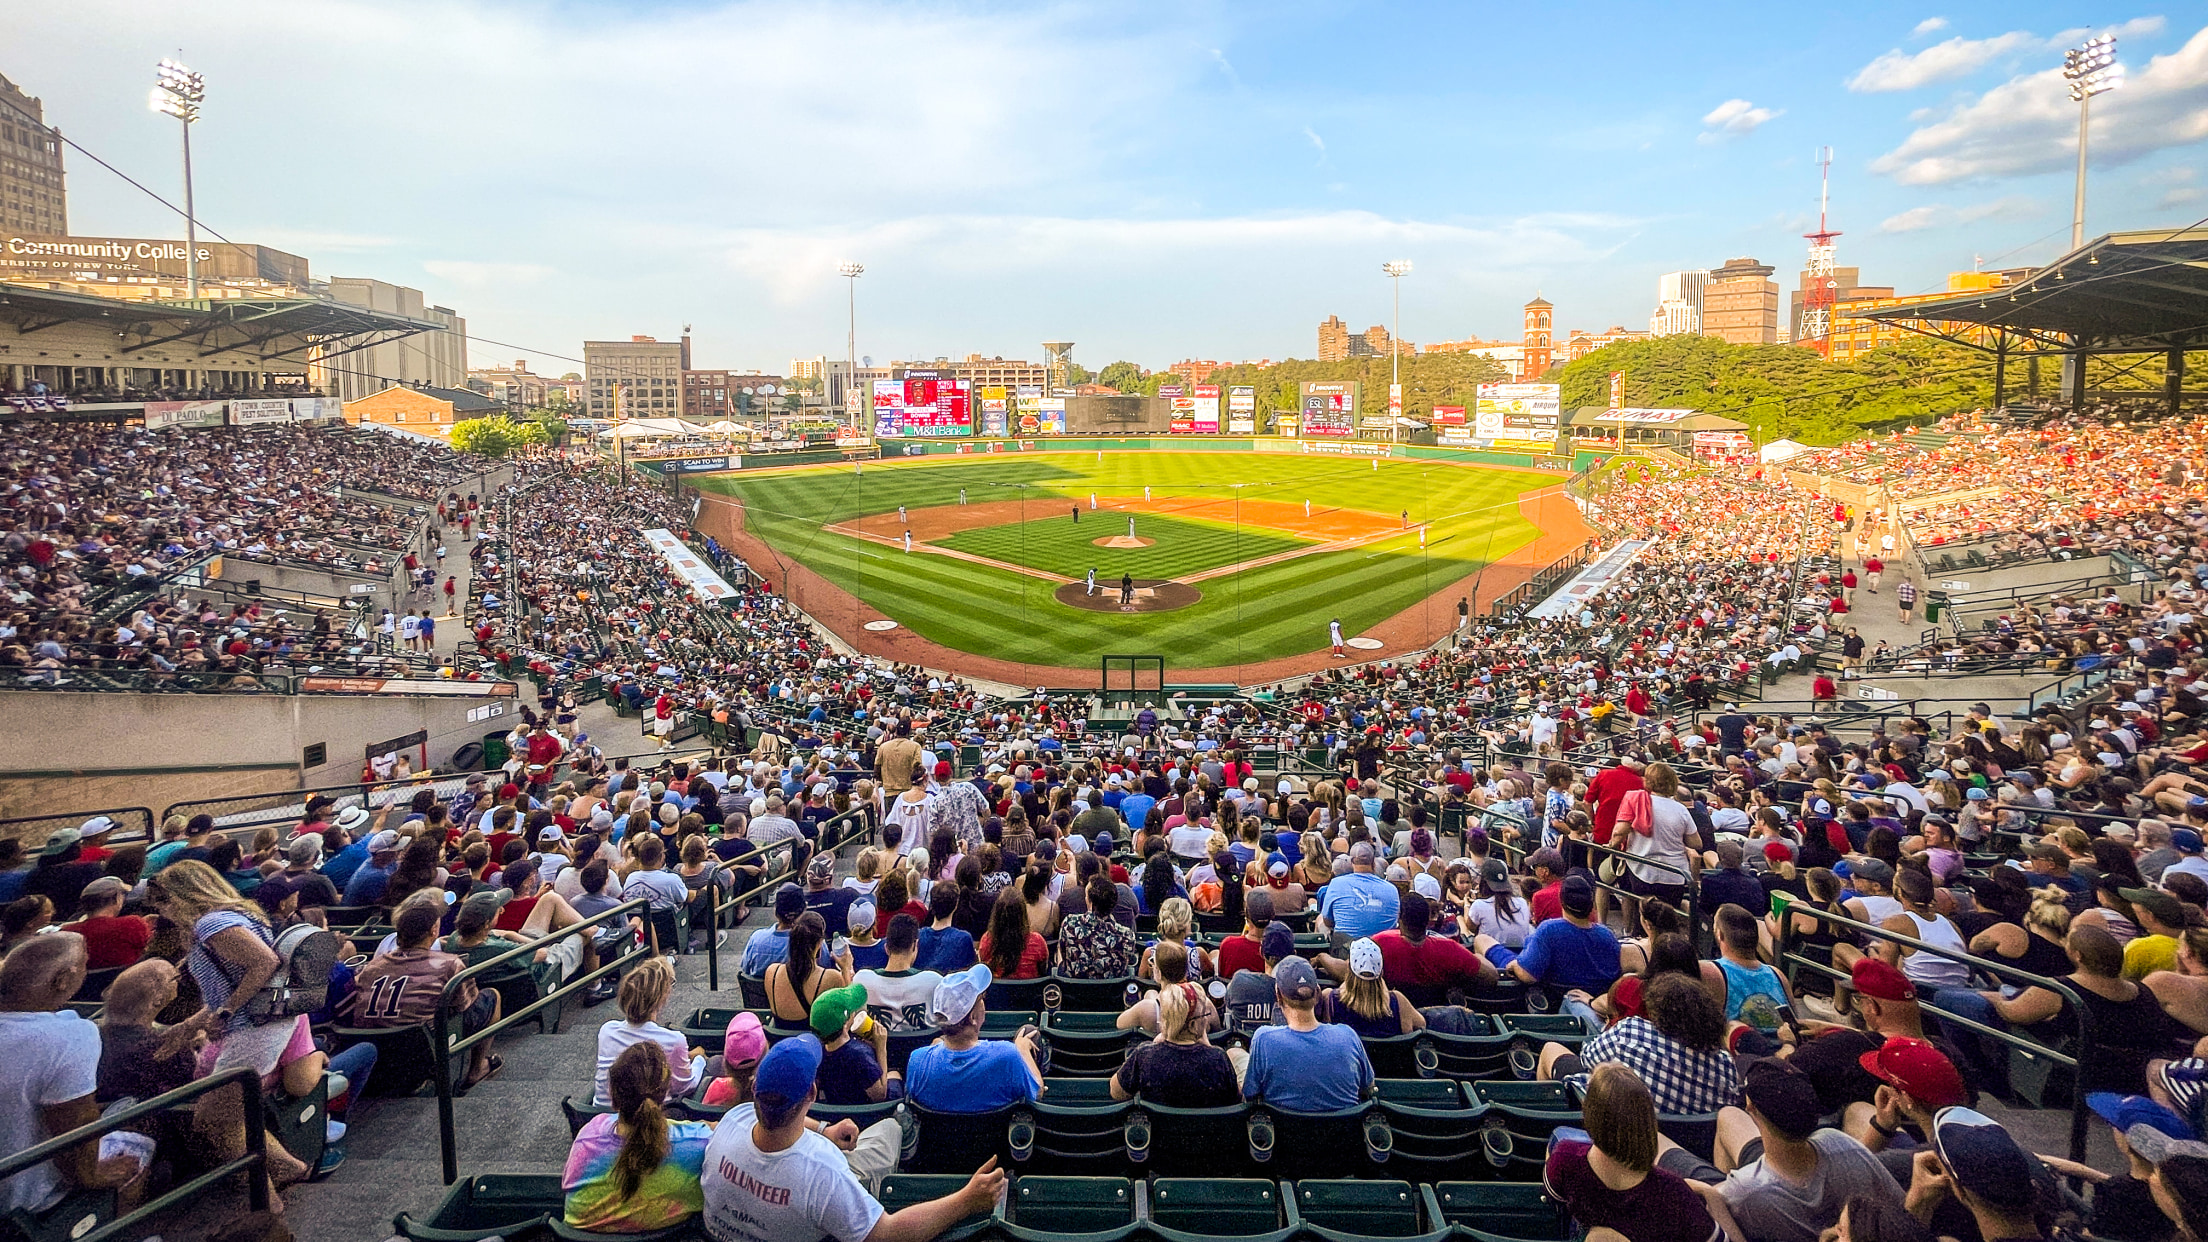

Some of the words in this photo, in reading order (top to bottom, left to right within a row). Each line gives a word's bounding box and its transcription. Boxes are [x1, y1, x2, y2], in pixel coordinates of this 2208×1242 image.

[8, 237, 132, 262] Community
[135, 242, 210, 263] Collee
[106, 263, 140, 271] YORK
[1309, 400, 1324, 409] ESL
[1532, 401, 1558, 409] AIRQUIP
[176, 410, 208, 422] PAOLO
[913, 426, 938, 436] M&T
[939, 426, 962, 435] Bank
[364, 974, 410, 1019] 11
[1247, 1002, 1271, 1020] RON
[718, 1155, 792, 1207] VOLUNTEER
[711, 1214, 745, 1238] TOWN
[721, 1203, 731, 1214] A
[731, 1209, 769, 1231] SMALL
